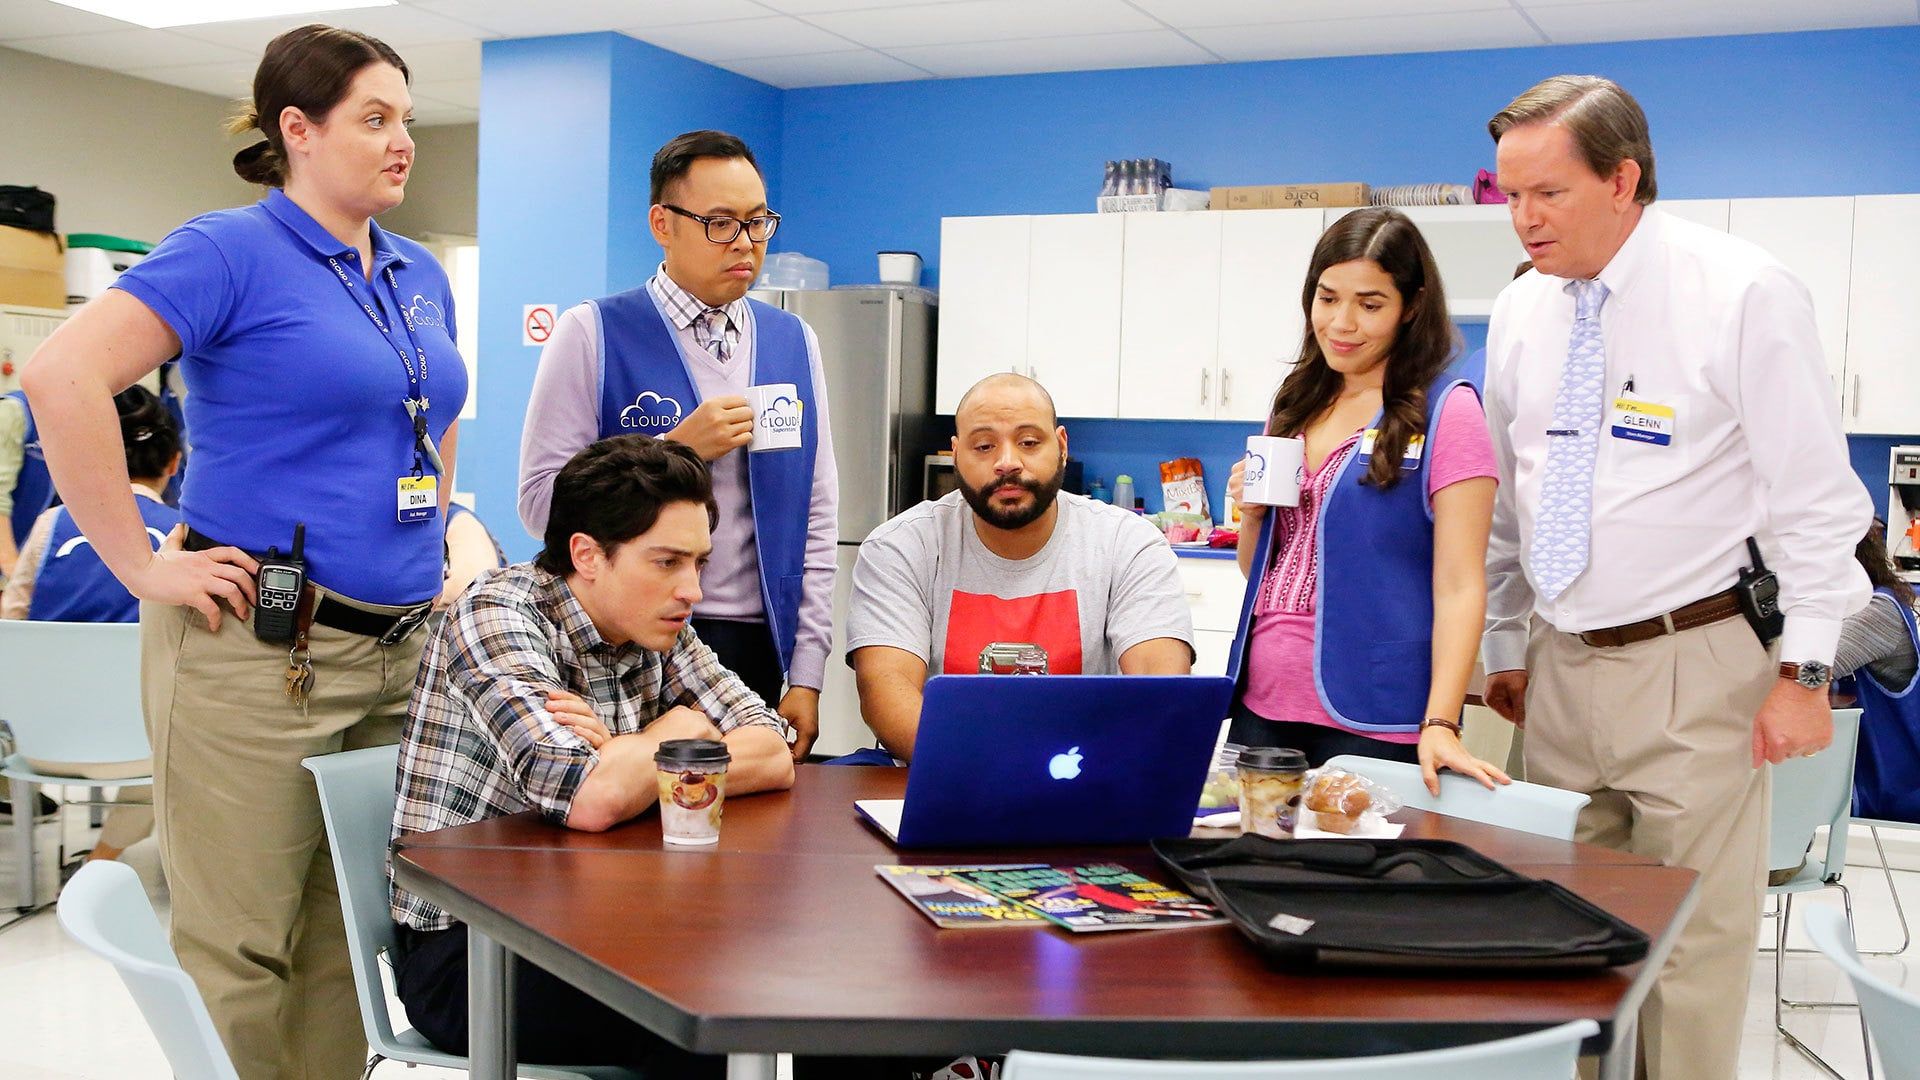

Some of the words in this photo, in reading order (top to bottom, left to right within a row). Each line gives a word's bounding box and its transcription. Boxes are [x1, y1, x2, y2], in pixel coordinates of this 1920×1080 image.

[329, 258, 348, 281] CLOUD
[364, 304, 383, 328] CLOUD
[400, 350, 414, 376] CLOUD
[620, 415, 680, 428] CLOUD9
[1623, 415, 1661, 429] GLENN
[410, 494, 427, 504] DINA
